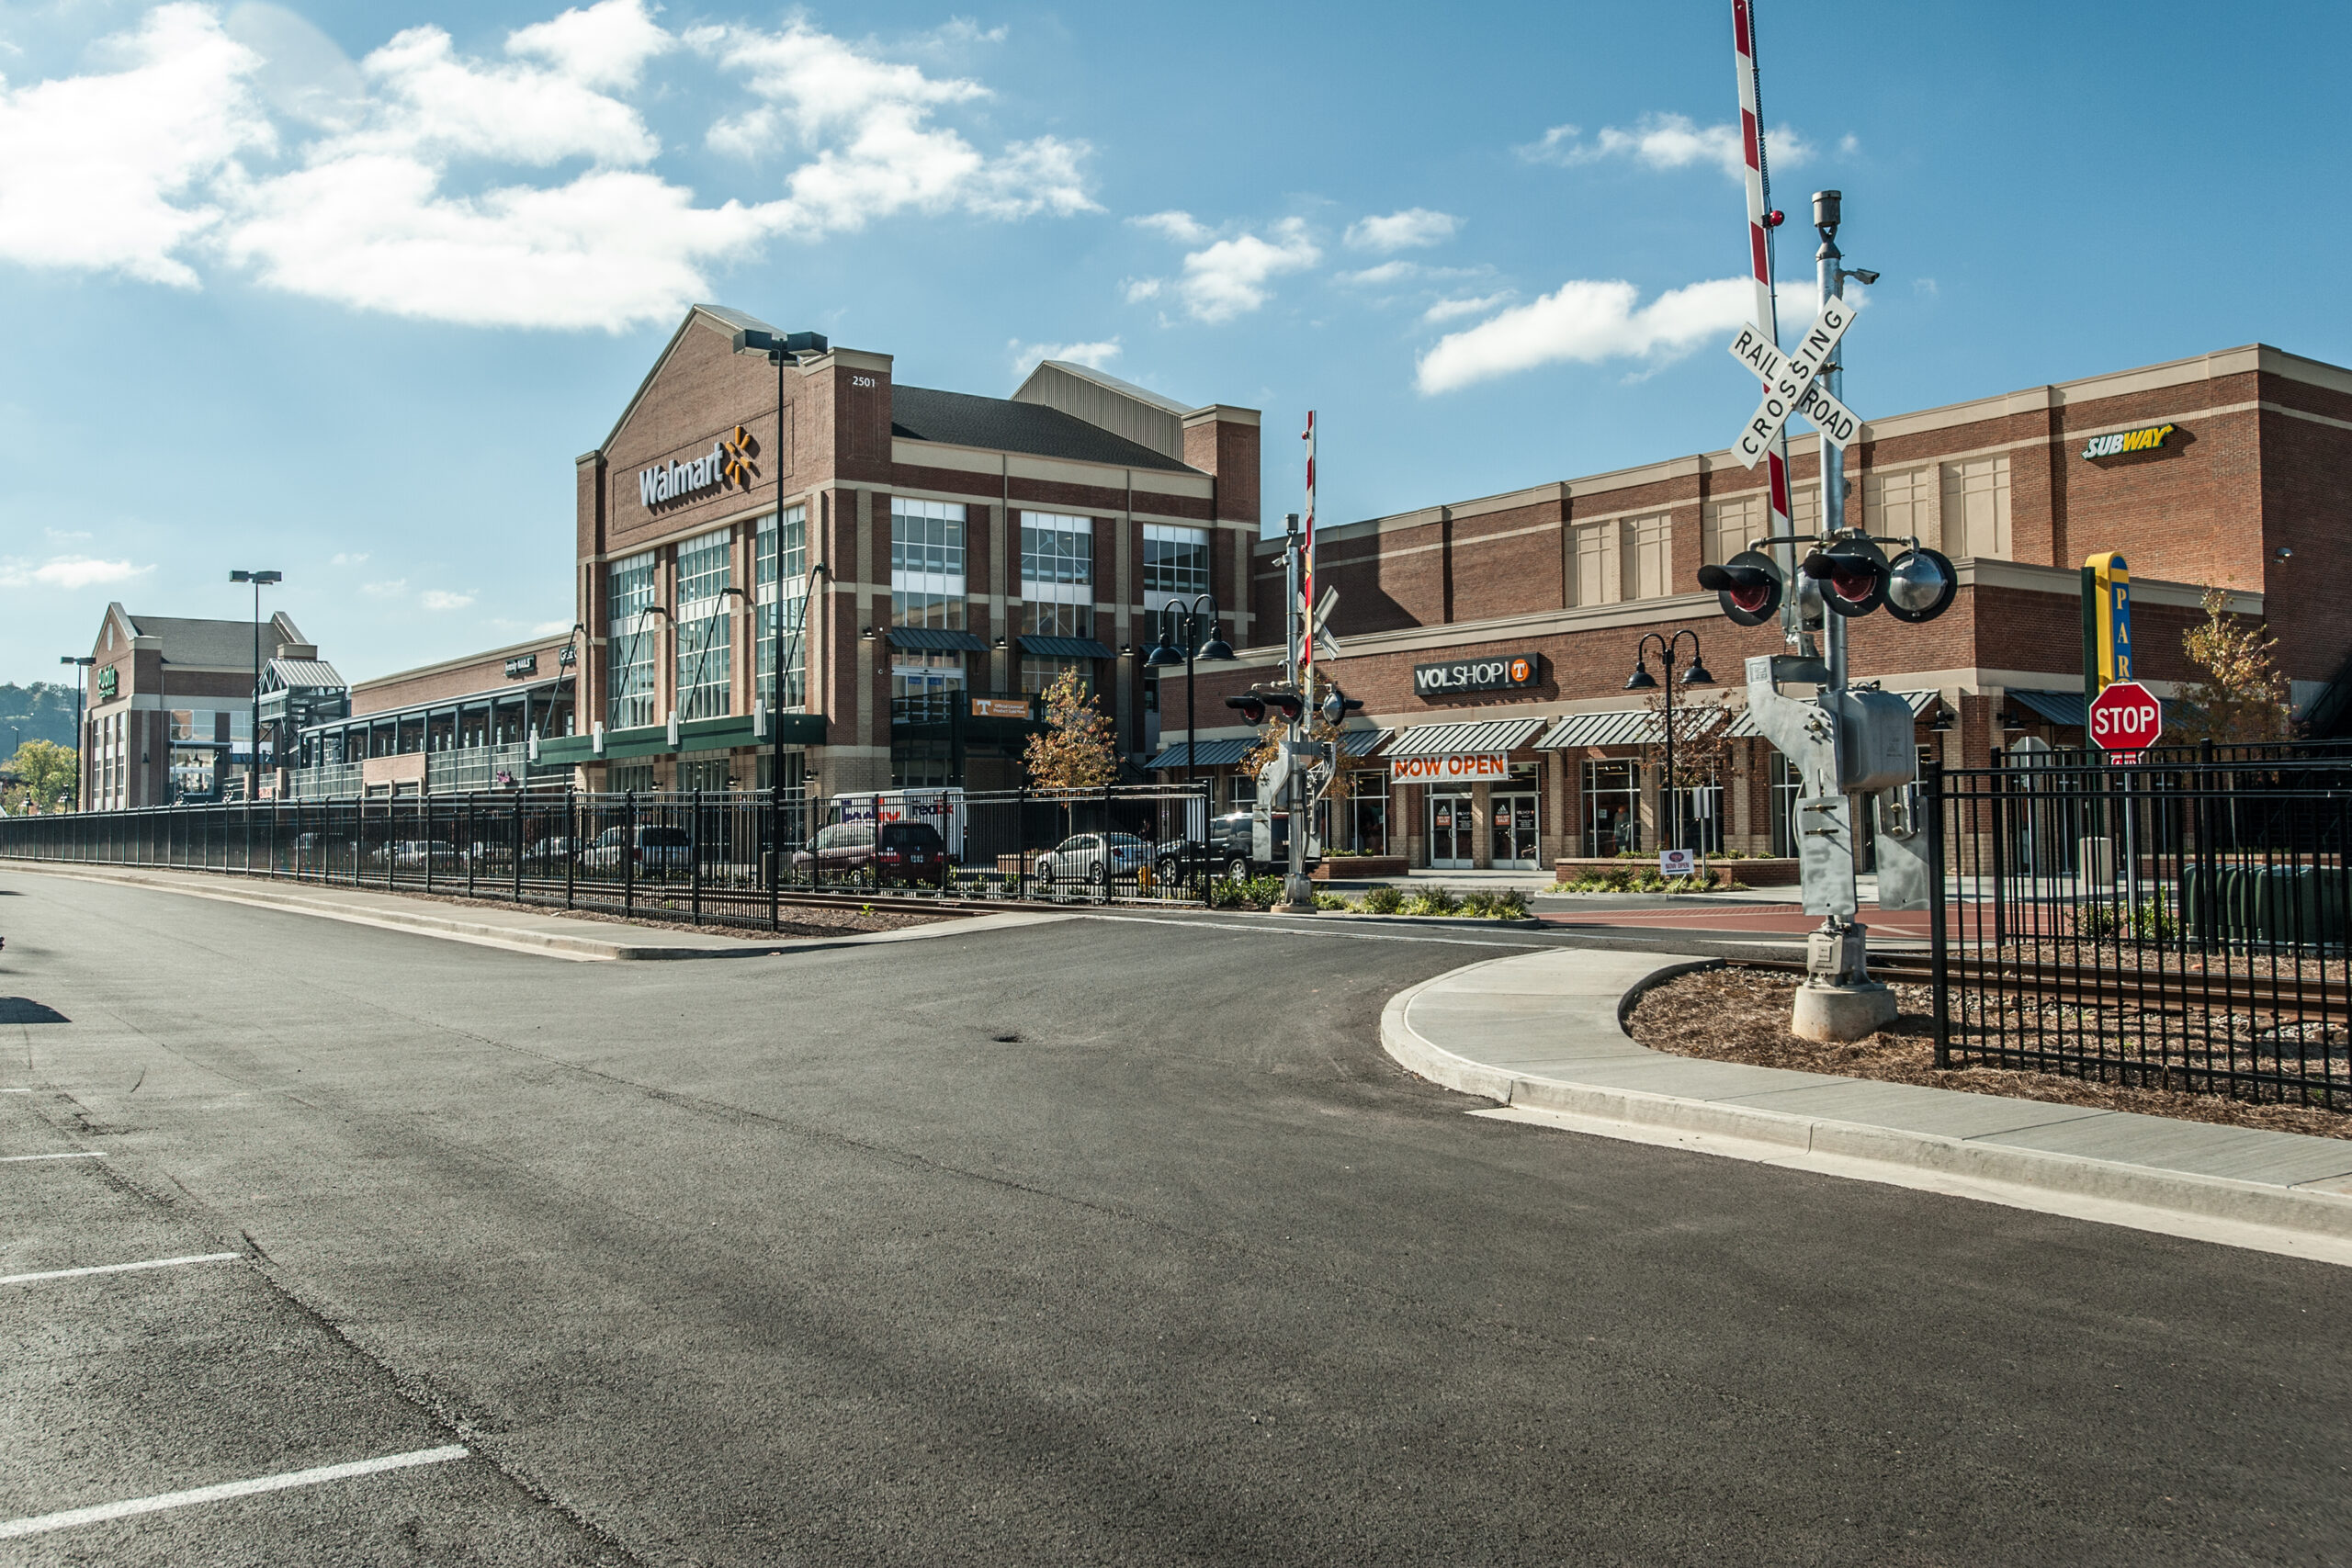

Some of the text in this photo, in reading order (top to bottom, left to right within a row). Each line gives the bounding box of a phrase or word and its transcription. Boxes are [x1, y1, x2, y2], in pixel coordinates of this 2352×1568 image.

[1735, 330, 1779, 381] RAIL
[853, 376, 876, 387] 2501
[1742, 310, 1842, 455] CROSSING
[1800, 388, 1853, 441] ROAD
[2082, 424, 2174, 458] SUBWAY
[639, 441, 723, 507] Walmart
[2115, 587, 2132, 682] PAR
[2095, 705, 2155, 735] STOP
[1395, 754, 1504, 778] NOW OPEN
